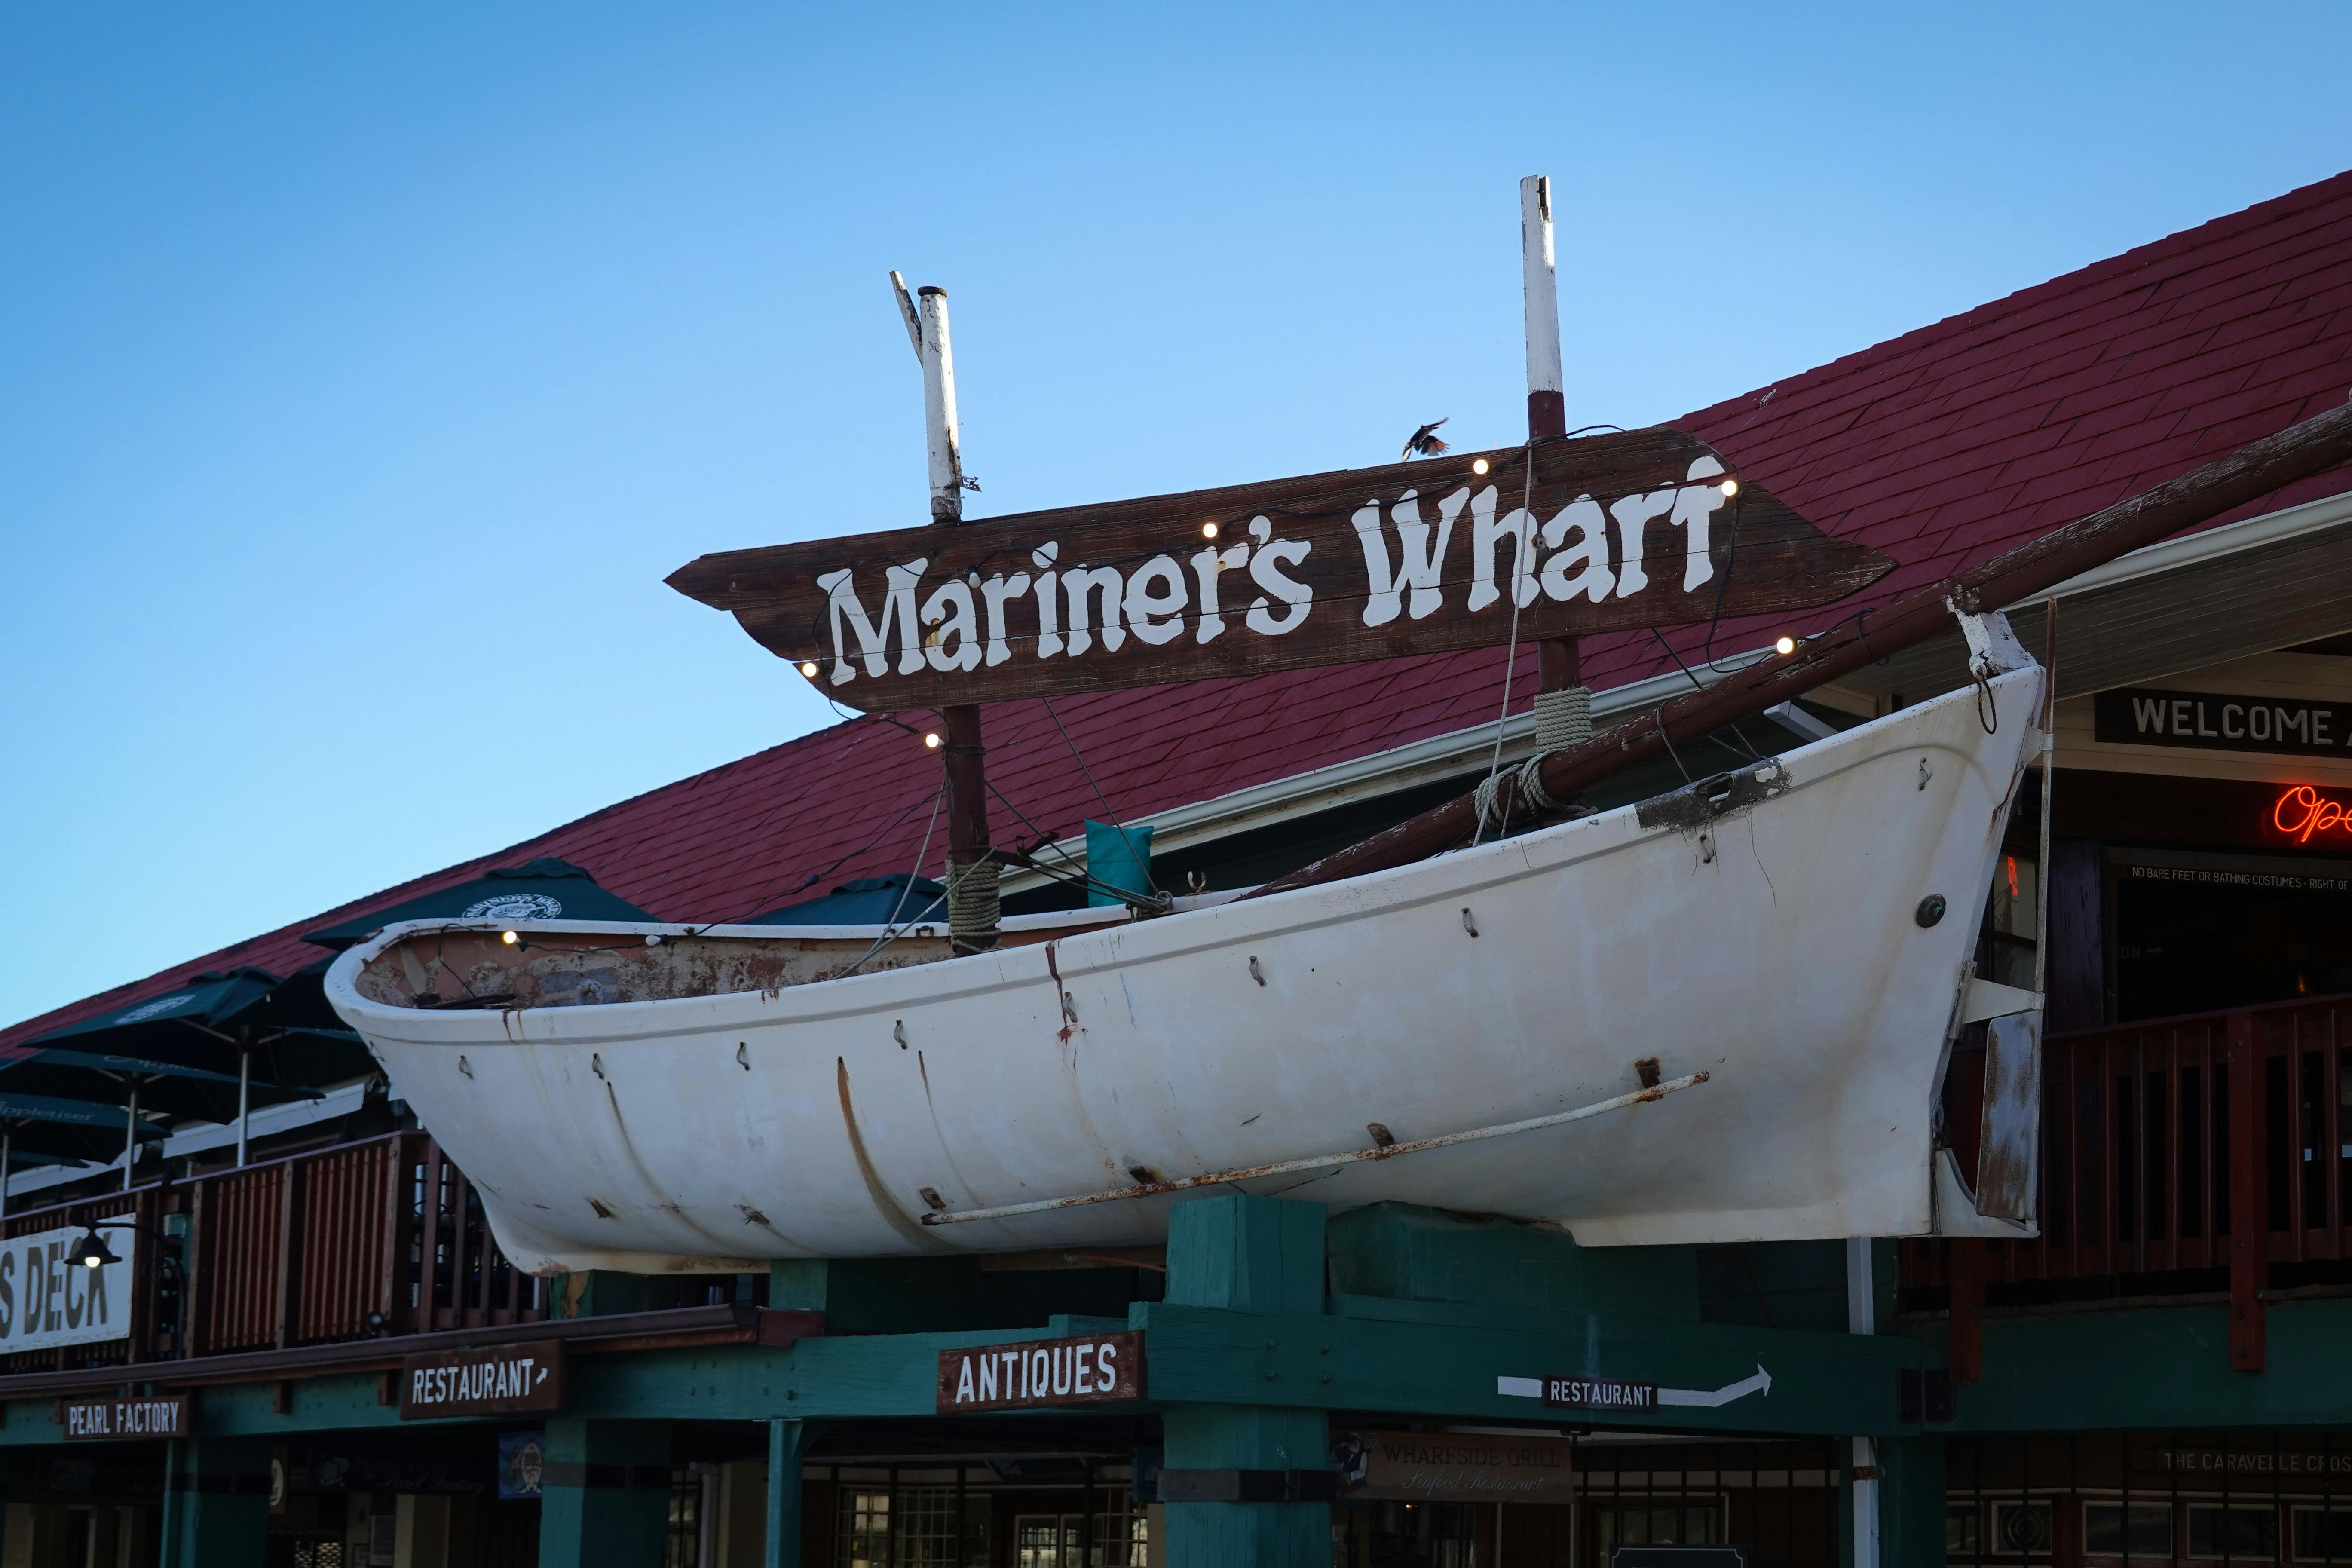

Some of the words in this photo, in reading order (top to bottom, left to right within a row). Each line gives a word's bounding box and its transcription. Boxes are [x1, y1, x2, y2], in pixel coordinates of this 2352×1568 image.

[817, 515, 1314, 687] Mariner's
[1351, 455, 1728, 628] Wharf
[2132, 698, 2333, 745] WELCOME
[2132, 867, 2144, 878] NO
[2147, 868, 2170, 880] BARE
[2173, 869, 2196, 882] FEET
[2199, 871, 2211, 882] OR
[2213, 871, 2250, 885] BATHING
[2252, 874, 2302, 888] COSTUMES
[2309, 879, 2334, 890] RIGHT
[2338, 880, 2349, 891] OF
[24, 1231, 113, 1335] DECK
[412, 1358, 535, 1404] RESTAURANT
[956, 1343, 1117, 1403] ANTIQUES
[1550, 1380, 1652, 1406] RESTAURANT
[69, 1404, 111, 1435] PEARL
[116, 1401, 180, 1433] FACTORY
[1364, 1433, 1386, 1449] The
[1384, 1445, 1499, 1466] WHARFSIDE
[1507, 1448, 1560, 1467] GRILL
[2163, 1452, 2196, 1469] THE
[2202, 1453, 2300, 1471] CARAVELLE
[377, 1470, 430, 1489] Pearl
[428, 1472, 486, 1497] Factory
[1402, 1468, 1464, 1496] Seafood
[1464, 1470, 1544, 1491] Restaurant
